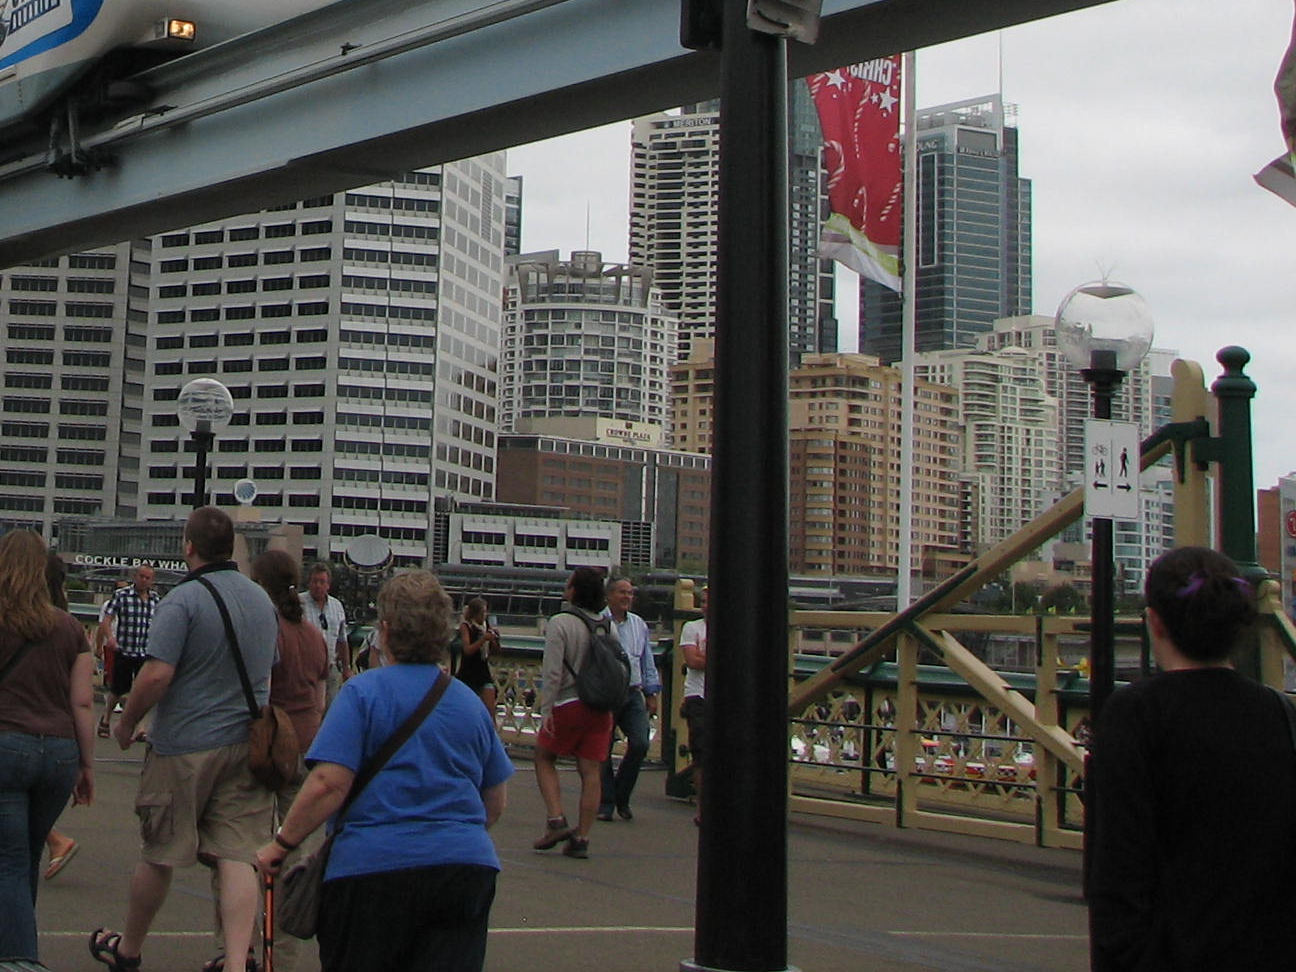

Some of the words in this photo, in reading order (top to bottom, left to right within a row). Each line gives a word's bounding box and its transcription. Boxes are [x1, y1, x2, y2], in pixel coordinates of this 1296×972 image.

[75, 554, 129, 567] COCKLE
[132, 558, 155, 568] BAY
[158, 560, 189, 571] WHA
